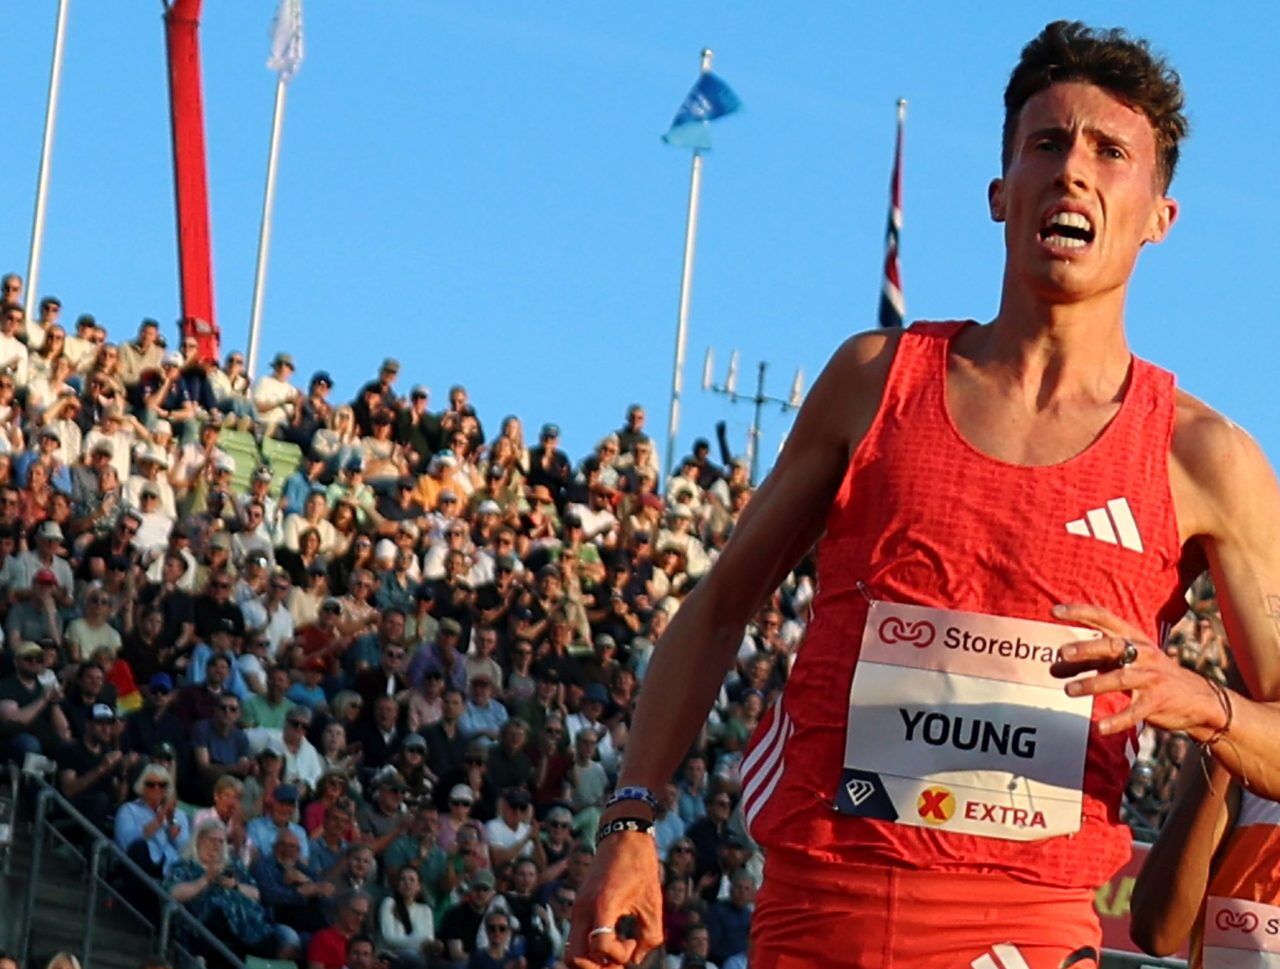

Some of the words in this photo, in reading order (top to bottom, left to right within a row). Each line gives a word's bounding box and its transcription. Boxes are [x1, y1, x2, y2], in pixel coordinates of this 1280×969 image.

[943, 626, 1066, 664] Storebra
[899, 707, 1037, 760] YOUNG
[963, 800, 1048, 829] EXTRA
